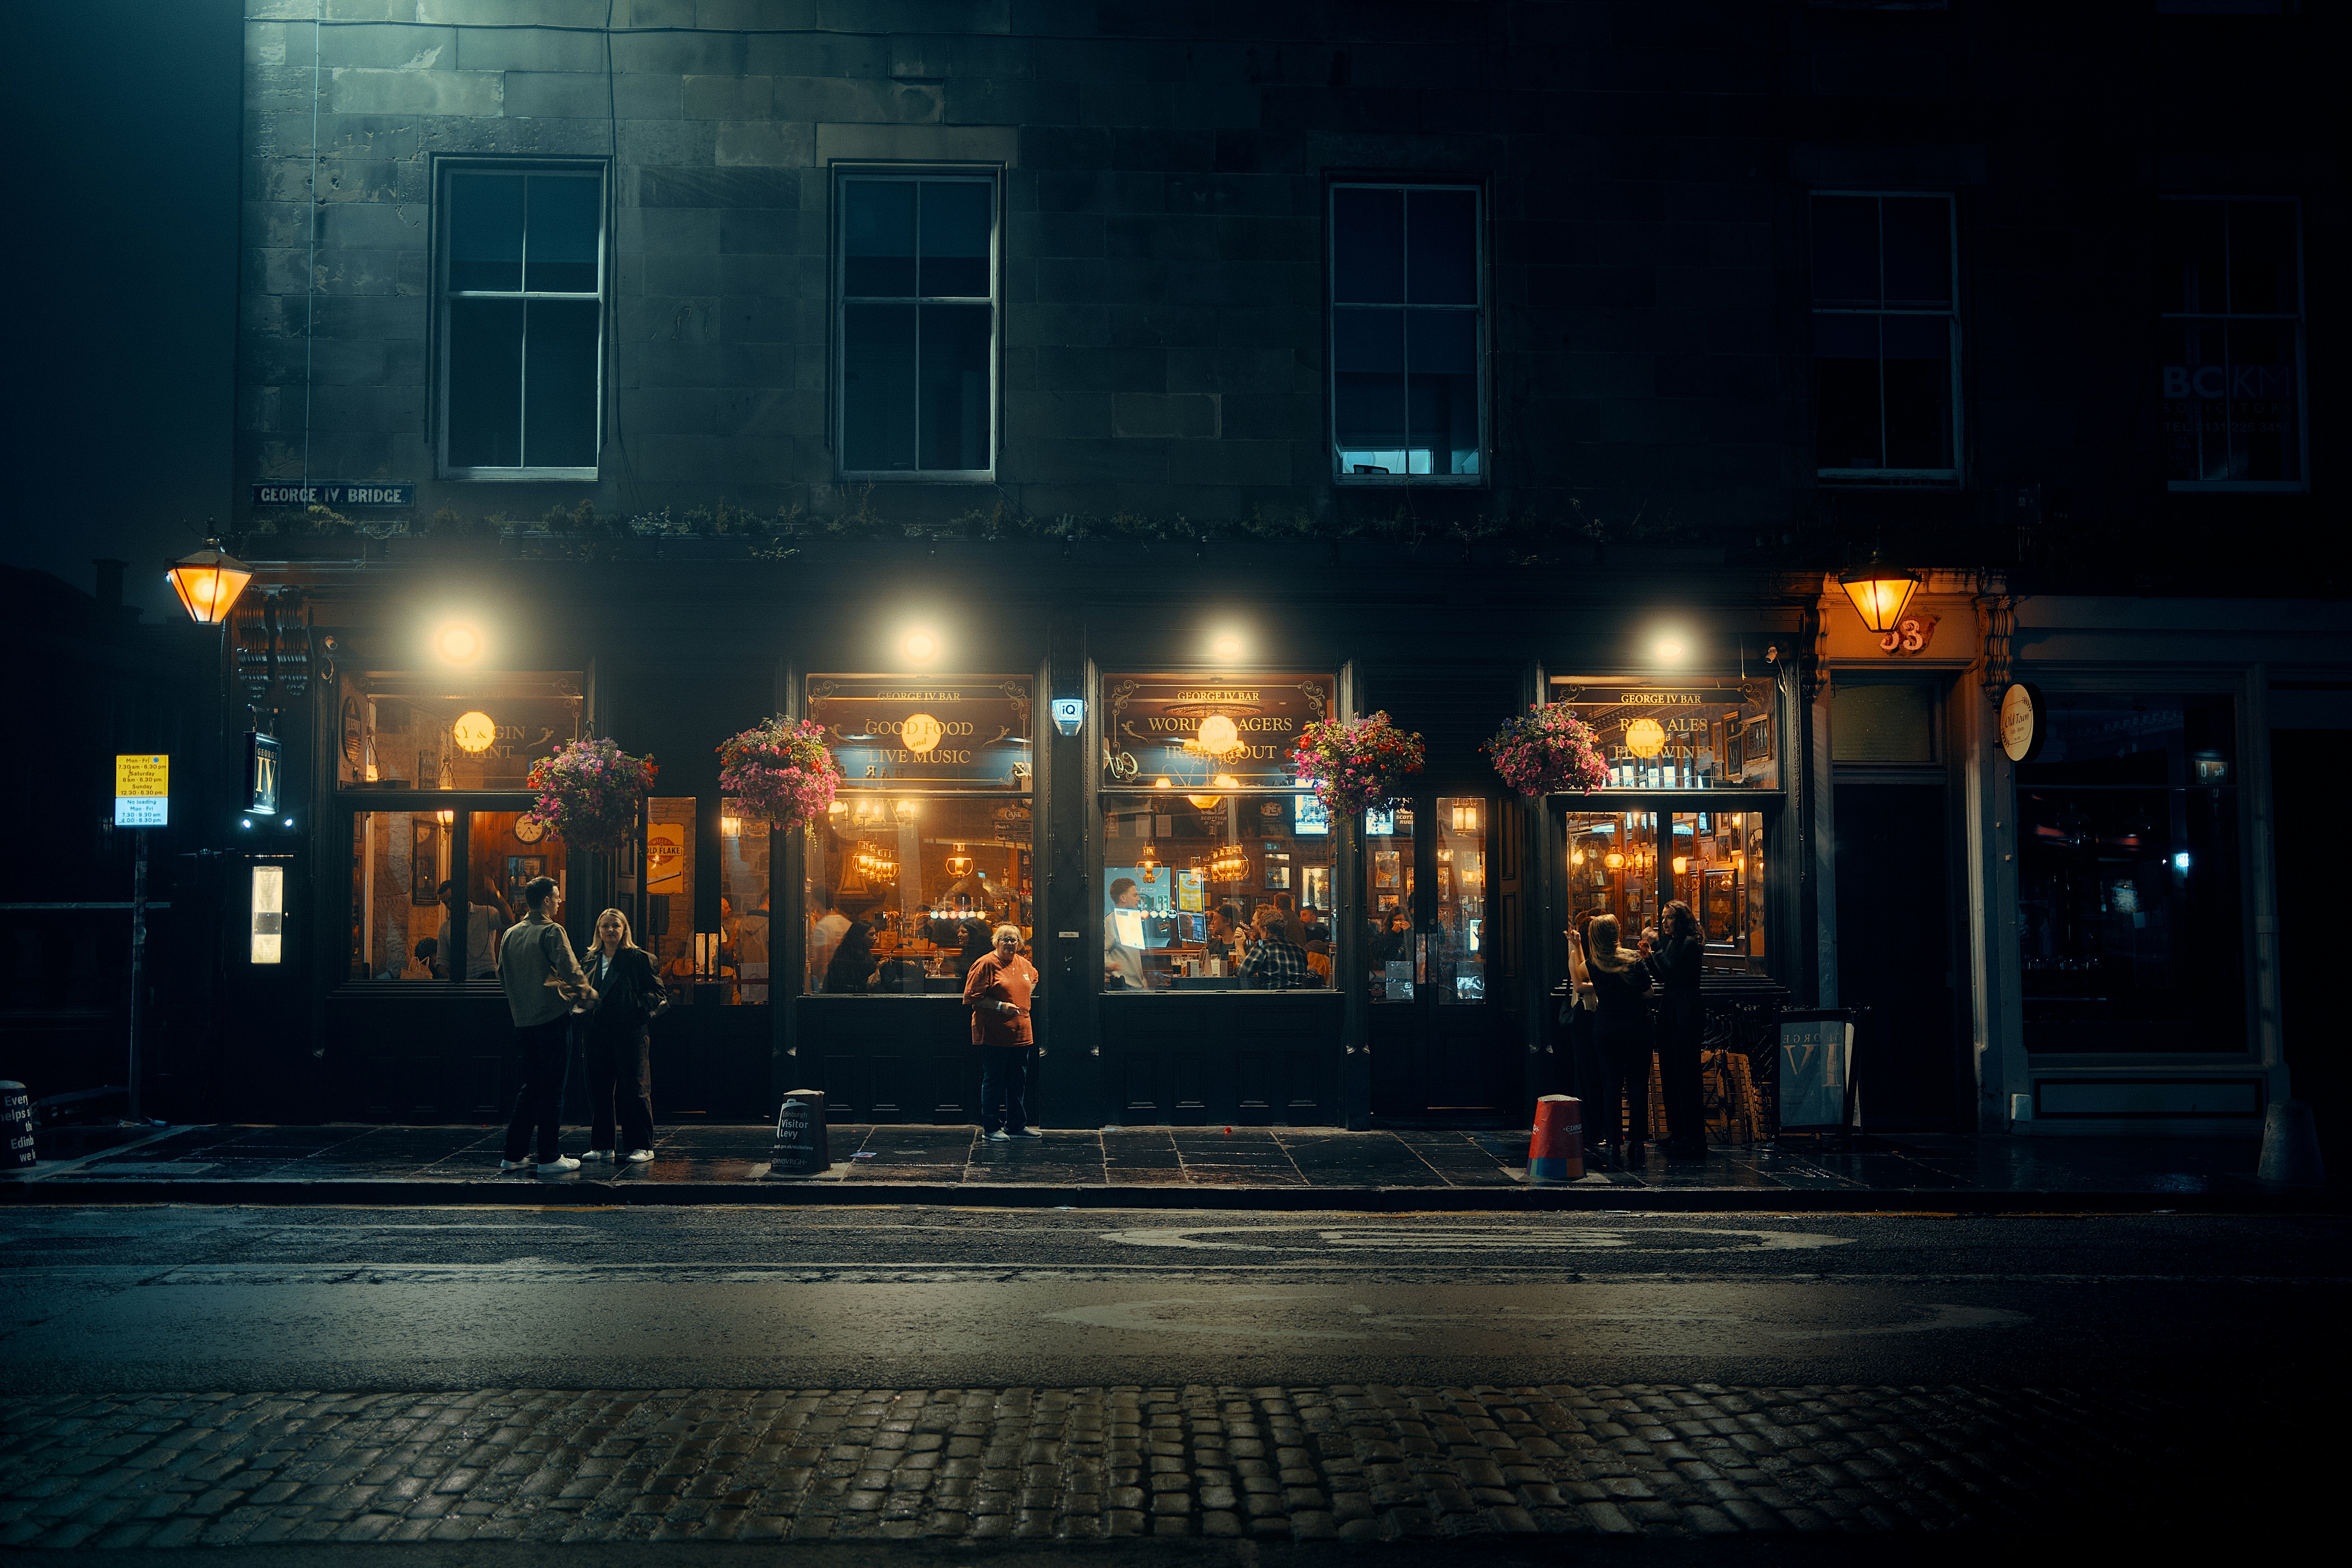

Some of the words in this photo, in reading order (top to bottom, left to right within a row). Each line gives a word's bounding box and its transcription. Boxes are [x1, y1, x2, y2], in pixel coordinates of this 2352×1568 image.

[2163, 365, 2290, 399] BCKM
[2163, 402, 2292, 414] SOLICITORS
[2232, 422, 2255, 433] 225
[261, 488, 317, 502] GEORGE
[878, 692, 922, 701] GEORGE
[939, 692, 961, 701] BAR
[1177, 692, 1222, 701] GEORGE
[1224, 692, 1235, 701] IV
[1239, 692, 1259, 701] BAR
[1621, 695, 1664, 703] GEORGE
[1666, 695, 1678, 703] IV
[1680, 695, 1701, 703] BAR
[1062, 704, 1075, 715] iQ
[1228, 717, 1292, 731] LAGERS
[1619, 718, 1664, 732] REAL
[1666, 718, 1708, 732] ALES
[2005, 713, 2015, 728] Old
[2016, 713, 2029, 725] Town
[492, 726, 525, 740] GIN
[865, 721, 918, 735] GOOD
[924, 721, 974, 736] FOOD
[911, 737, 927, 747] and
[1213, 733, 1227, 744] and
[1656, 733, 1671, 744] and
[257, 748, 277, 760] GEORGE
[868, 749, 908, 763] LIVE
[912, 749, 971, 764] MUSIC
[1164, 745, 1212, 759] IRISH
[1222, 745, 1277, 760] STOUT
[1613, 746, 1654, 759] FINE
[1659, 746, 1714, 759] WINES
[255, 756, 277, 795] IV
[782, 1119, 809, 1129] Visitor
[780, 1128, 799, 1140] Levy
[19, 1152, 31, 1162] we
